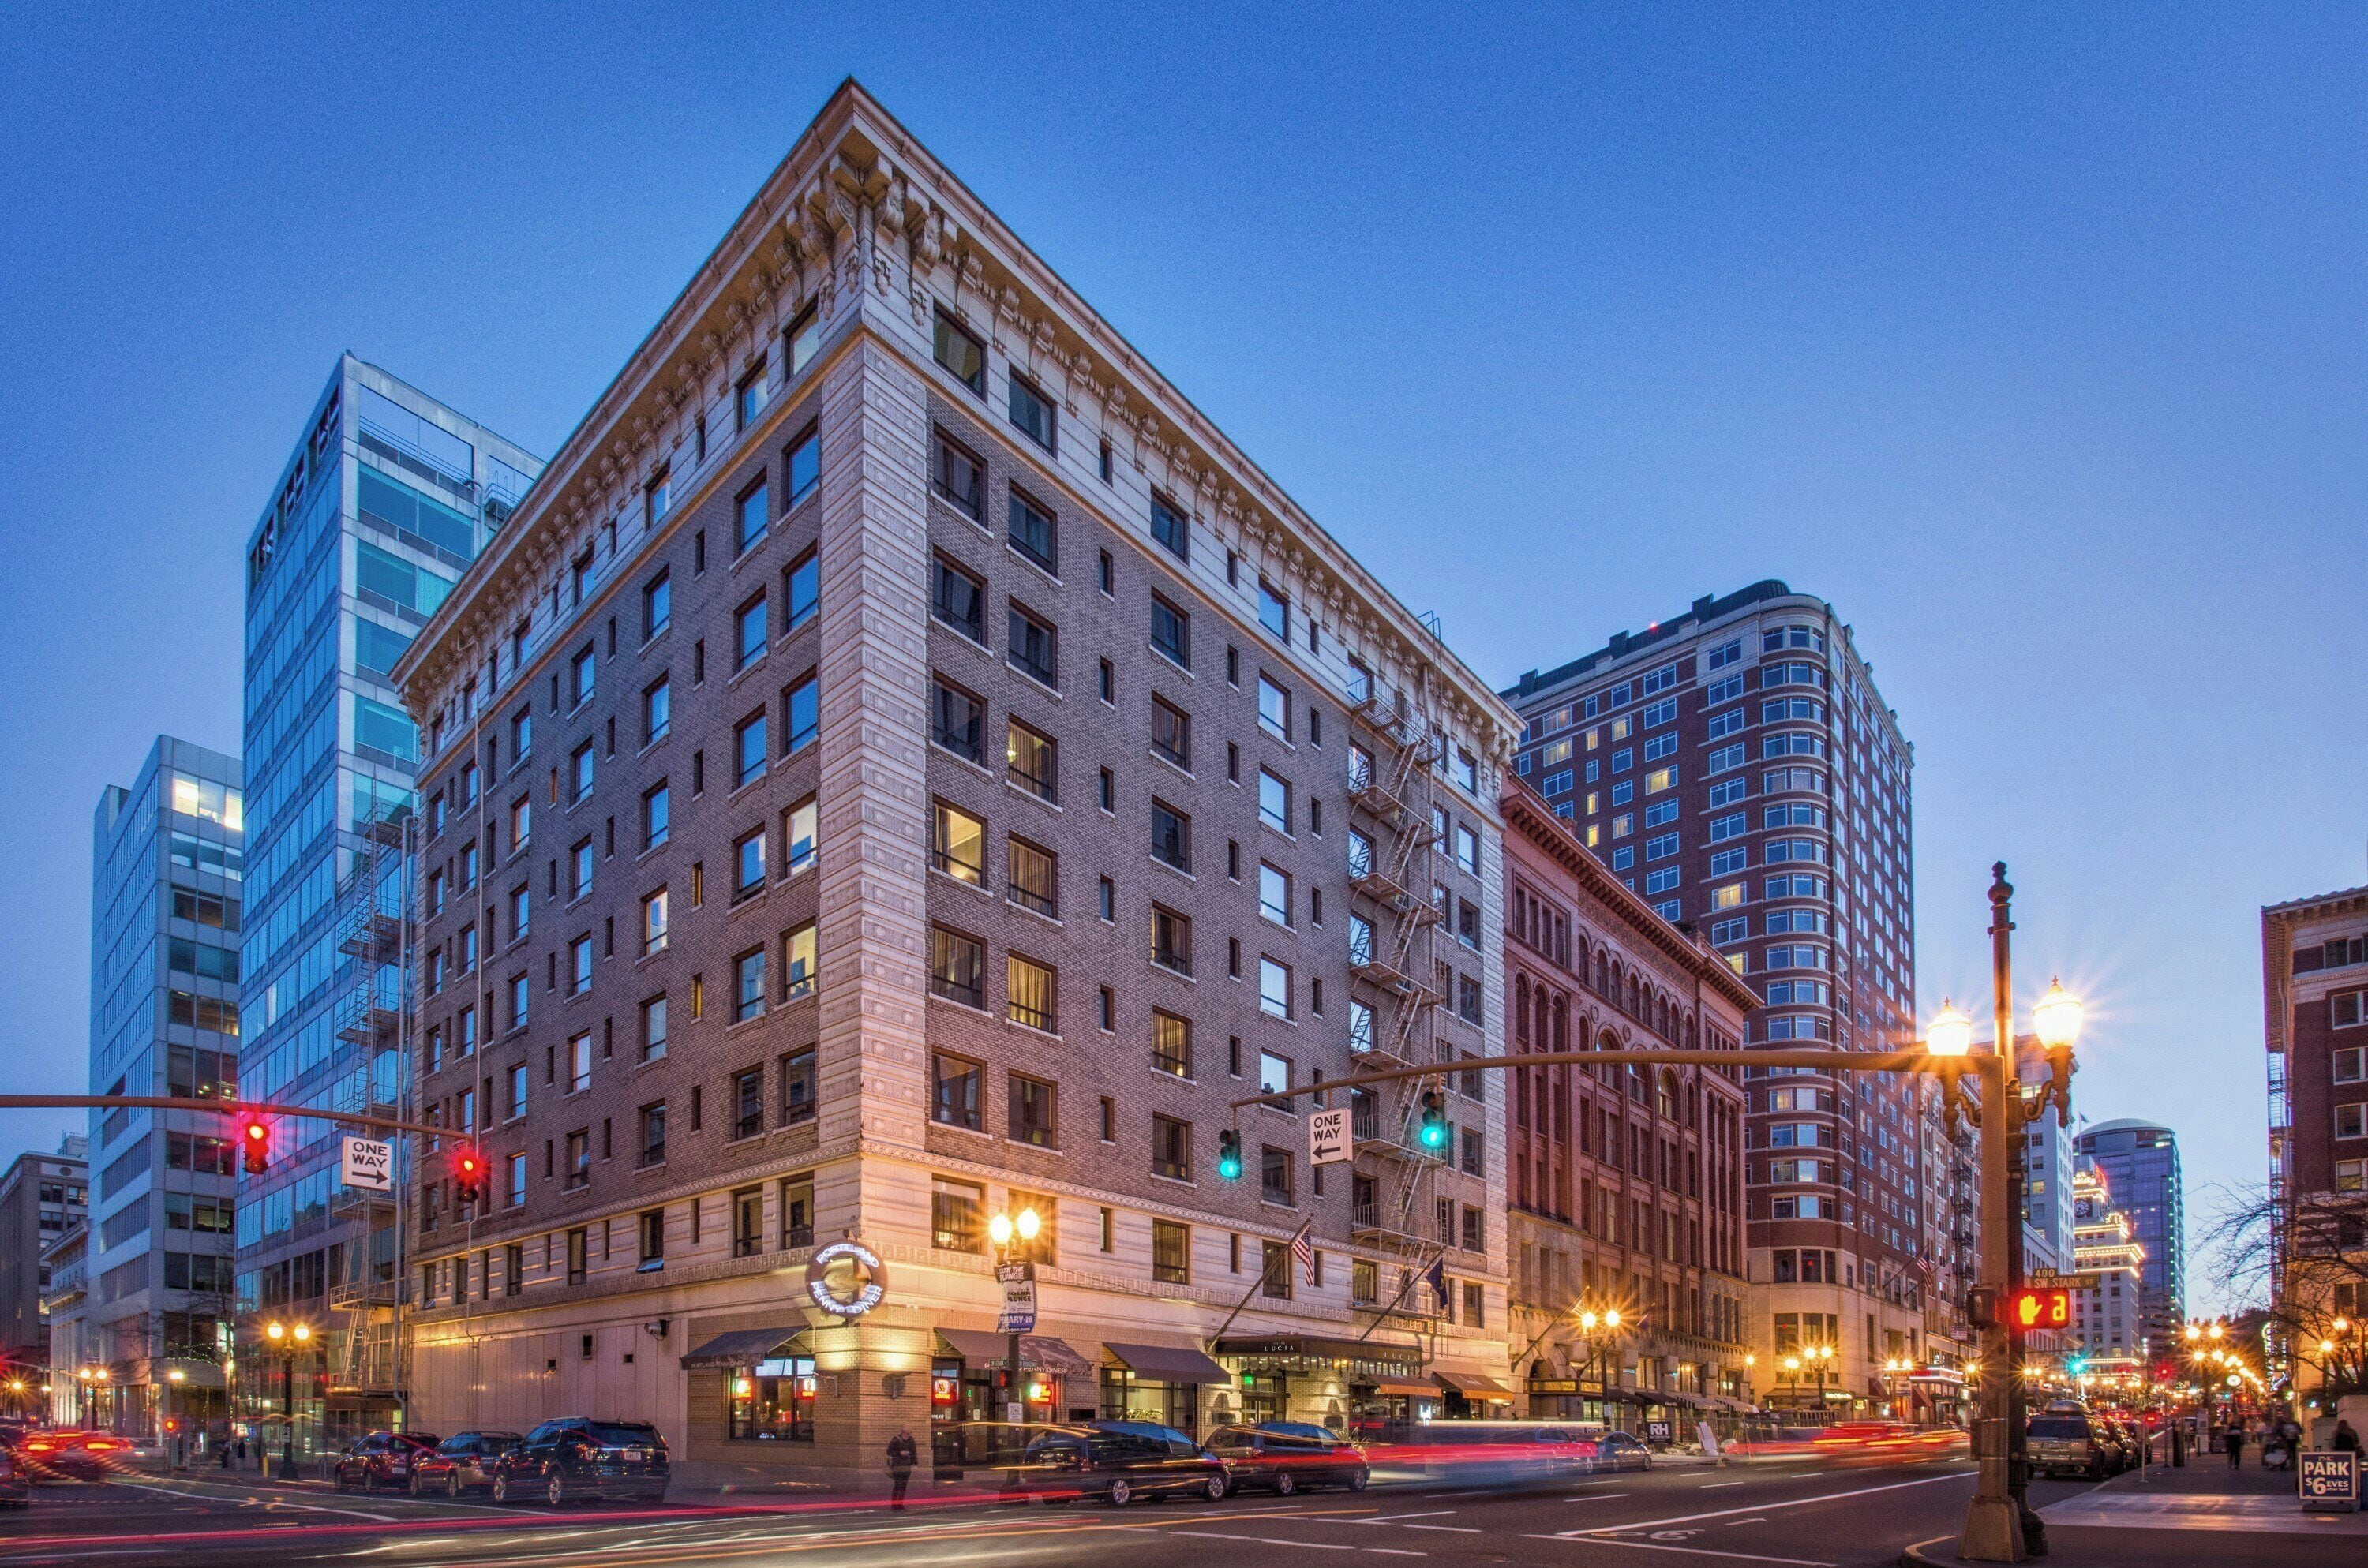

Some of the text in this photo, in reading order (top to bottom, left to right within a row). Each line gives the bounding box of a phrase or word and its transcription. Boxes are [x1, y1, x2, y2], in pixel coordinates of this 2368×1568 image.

[1314, 1113, 1341, 1128] ONE
[1313, 1127, 1341, 1142] WAY
[353, 1142, 387, 1156] ONE
[352, 1154, 388, 1168] WAY
[816, 1244, 879, 1268] PORTLAND
[999, 1271, 1025, 1281] PLUNGE
[2035, 1269, 2055, 1278] 400
[2034, 1278, 2048, 1288] SW
[2052, 1278, 2081, 1288] STARK
[811, 1281, 883, 1314] PENNY DINER
[1383, 1351, 1418, 1362] LUCIA
[1650, 1423, 1669, 1435] RH
[2304, 1461, 2350, 1476] PARK
[2305, 1477, 2326, 1495] $6
